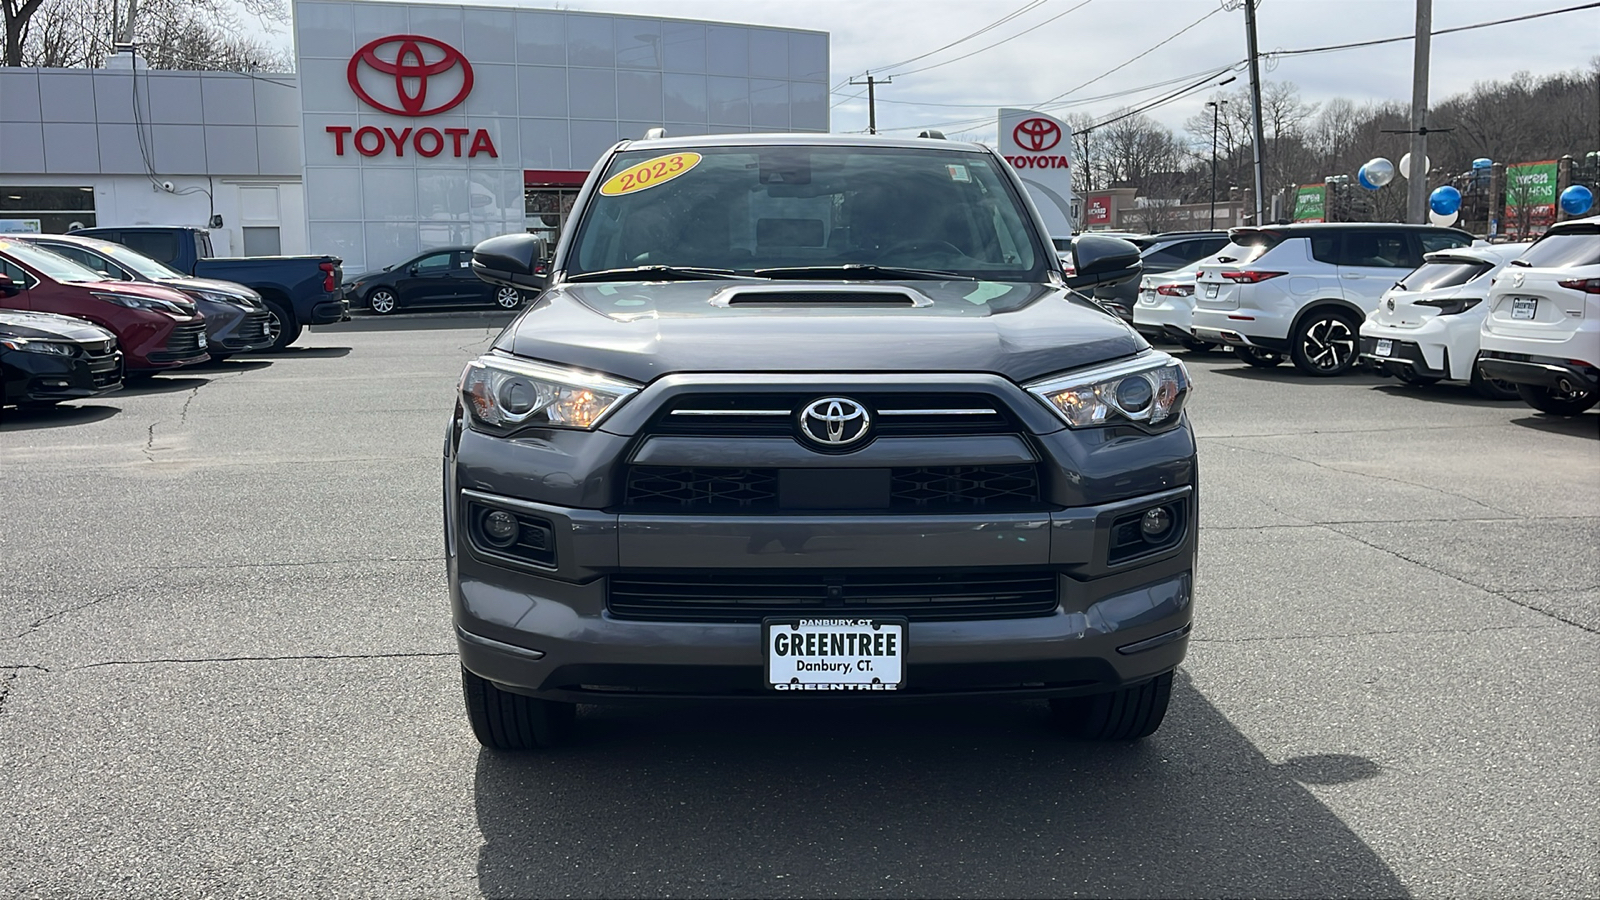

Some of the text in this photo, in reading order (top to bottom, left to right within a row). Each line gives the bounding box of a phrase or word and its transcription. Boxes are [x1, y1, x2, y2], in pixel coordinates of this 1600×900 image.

[326, 126, 498, 158] TOYOTA
[1003, 156, 1069, 169] TOYOTA
[620, 156, 684, 191] 2023
[800, 619, 872, 627] DANBURY, CT
[774, 633, 897, 656] GREENTREE
[796, 659, 874, 674] Danbury, CT.
[774, 683, 898, 691] GREENTREE
